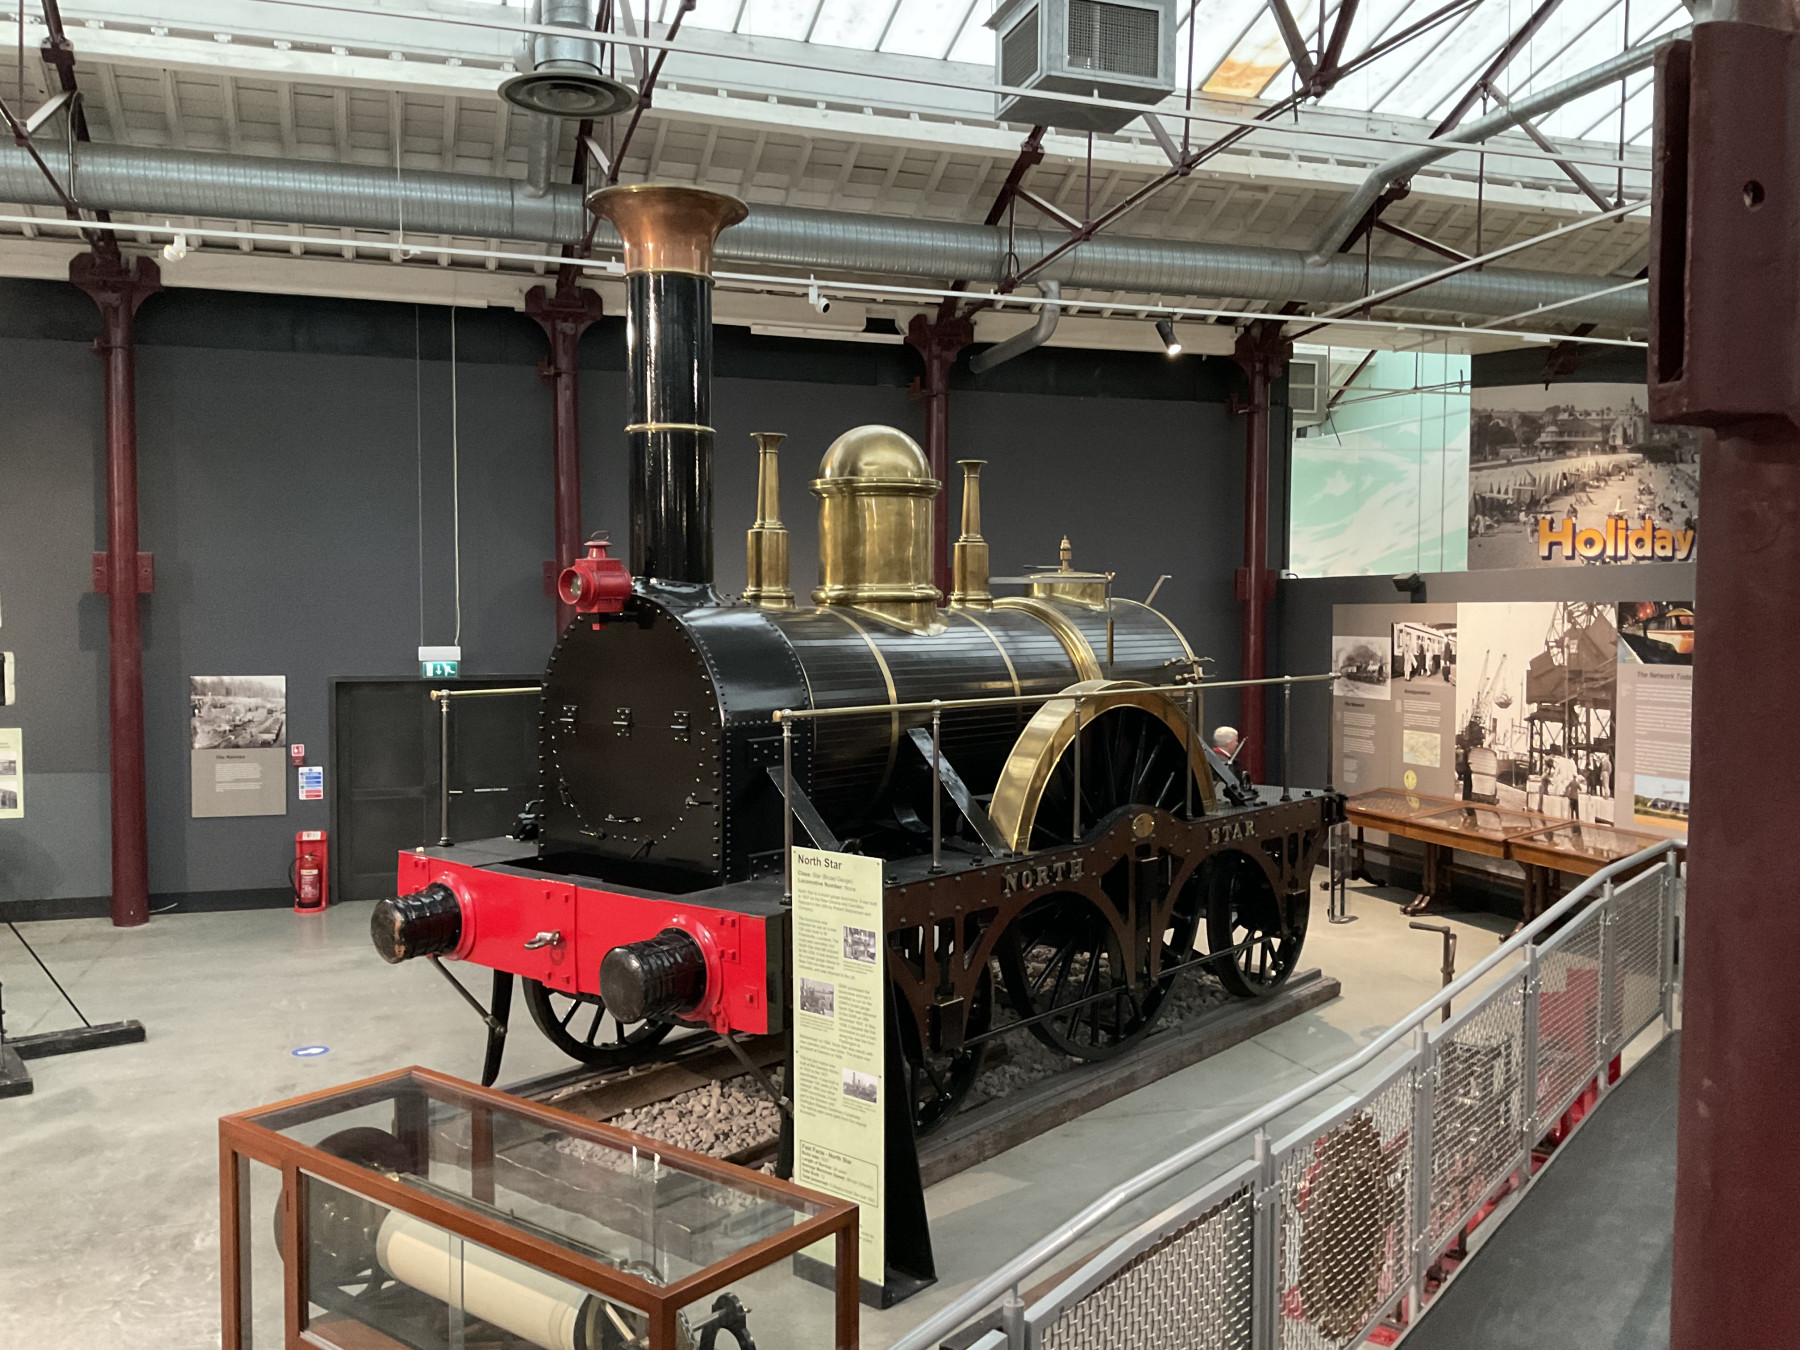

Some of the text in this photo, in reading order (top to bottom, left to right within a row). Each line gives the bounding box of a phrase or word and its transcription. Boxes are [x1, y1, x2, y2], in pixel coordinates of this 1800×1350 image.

[1538, 518, 1695, 561] Holiday
[1211, 820, 1255, 845] STAR
[798, 854, 842, 870] North Star
[1003, 858, 1084, 895] NORTH
